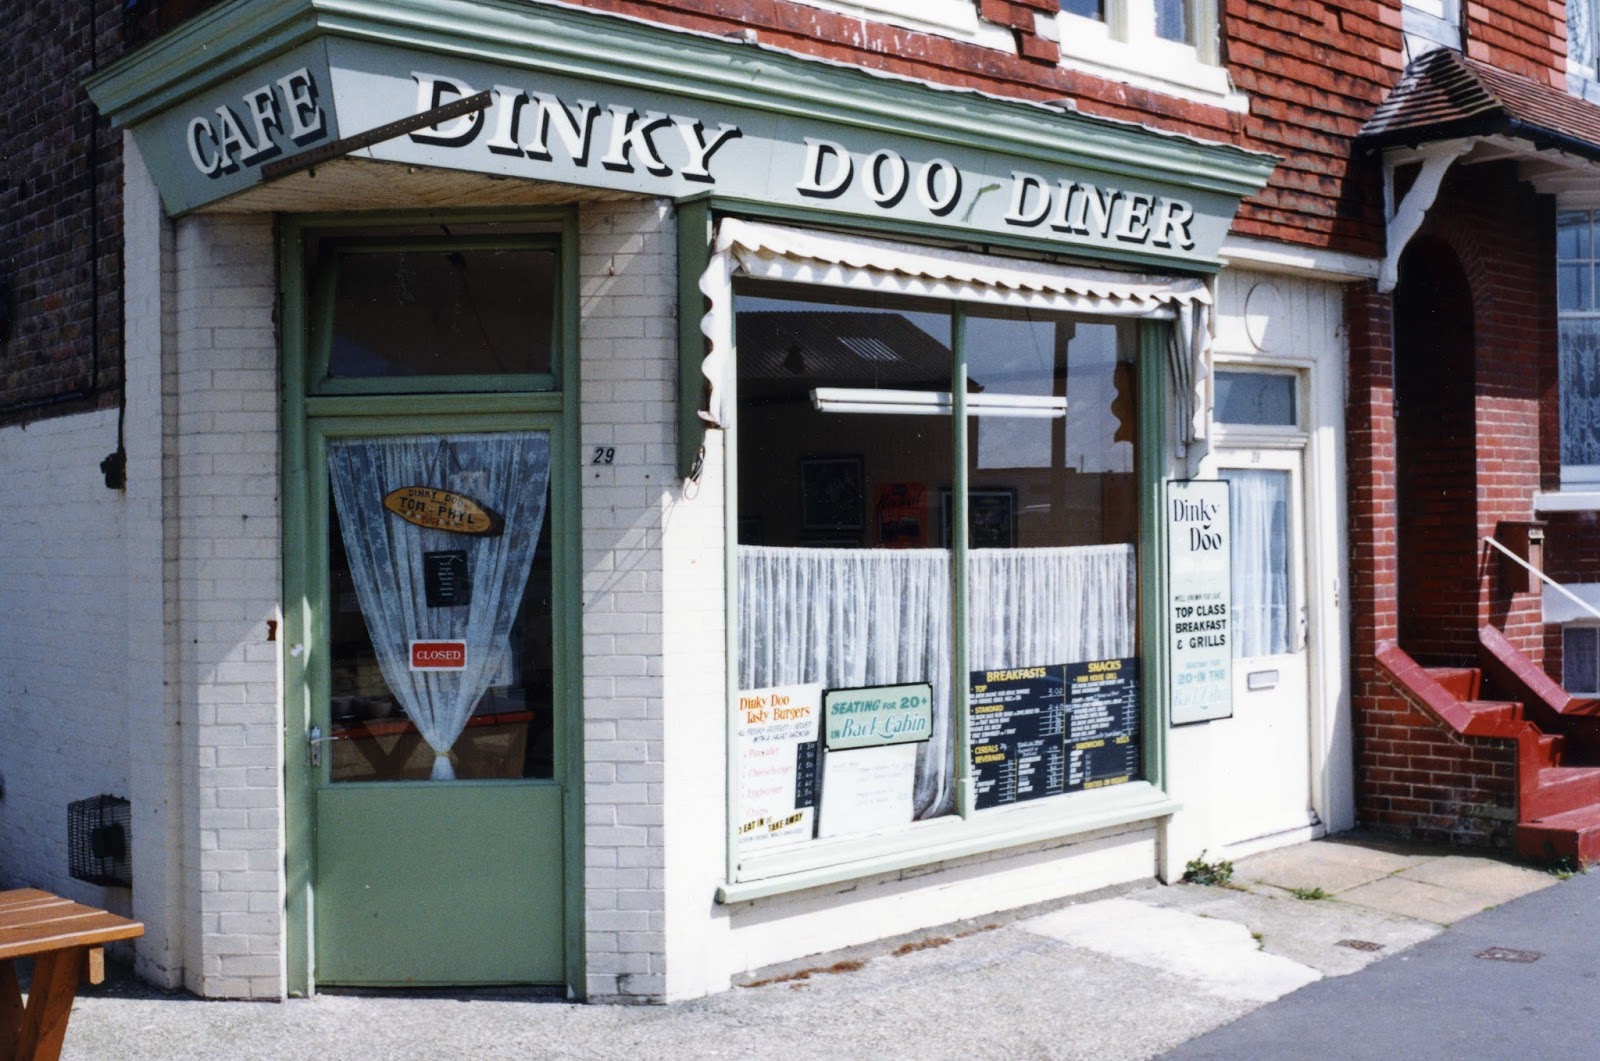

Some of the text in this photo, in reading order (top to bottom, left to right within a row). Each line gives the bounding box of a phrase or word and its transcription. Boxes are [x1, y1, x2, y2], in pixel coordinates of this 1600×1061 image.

[186, 67, 327, 179] CAFE
[409, 71, 1196, 251] DINKY DOO DINER
[592, 447, 615, 464] 29
[408, 489, 438, 500] DINKY
[400, 496, 426, 512] TOM
[438, 506, 475, 524] PHYL
[1173, 498, 1221, 523] Dinky
[1190, 526, 1222, 551] Doo
[1175, 604, 1226, 618] TOP CLASS
[1175, 619, 1227, 633] BREAKFAST
[1189, 634, 1226, 649] GRILLS
[416, 650, 461, 661] CLOSED
[1087, 660, 1122, 672] SNACKS
[986, 667, 1047, 682] BREAKFASTS
[739, 694, 790, 711] Dinky Doo
[831, 699, 881, 715] SEATING
[883, 702, 897, 710] FOR
[747, 706, 811, 724] Tasty Burgers
[830, 730, 840, 739] IN
[885, 713, 926, 734] Cabin
[975, 744, 999, 754] CEREALS
[975, 753, 1005, 763] BEVERAGES
[743, 820, 756, 833] EAT
[757, 818, 764, 826] IN
[768, 811, 803, 832] TAKE AWAY
